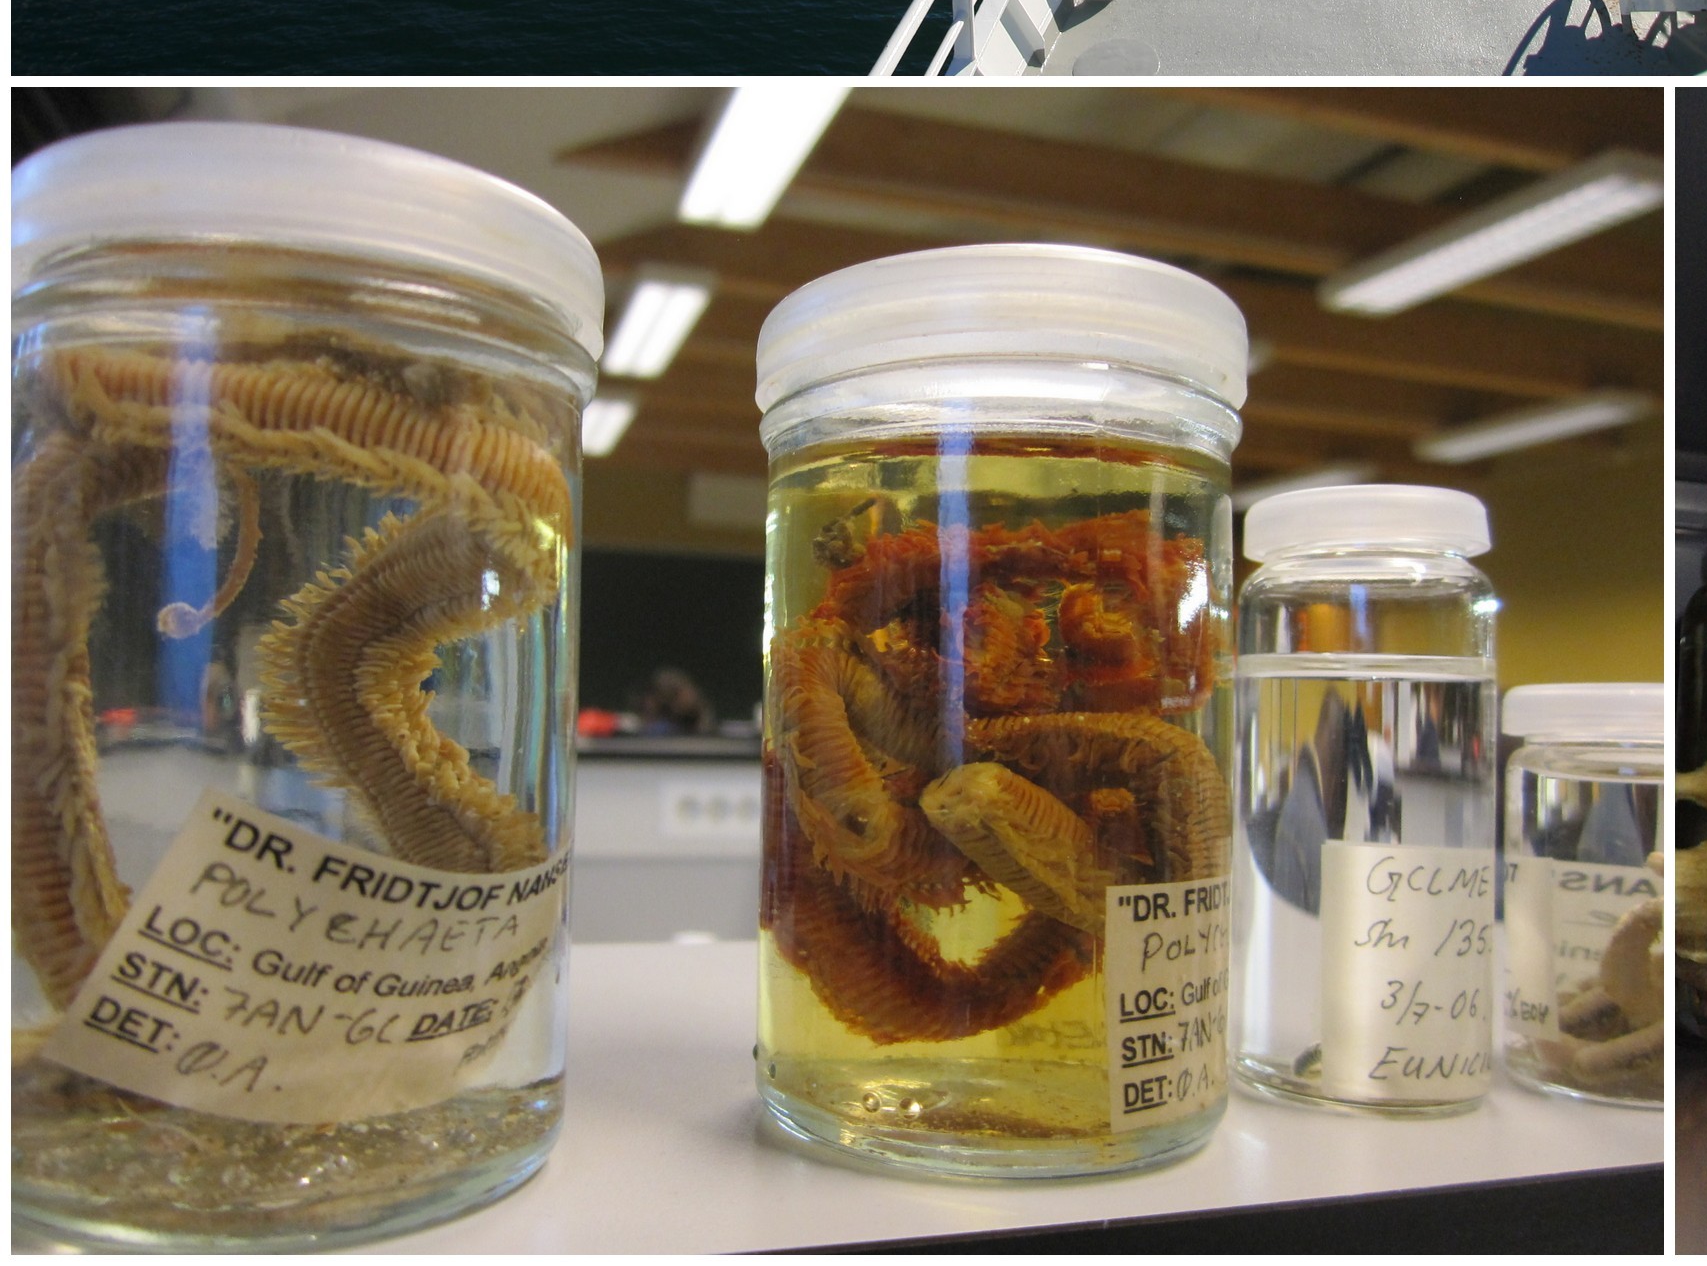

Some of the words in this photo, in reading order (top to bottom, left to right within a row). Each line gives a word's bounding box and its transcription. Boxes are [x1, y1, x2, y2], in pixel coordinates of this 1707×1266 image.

[212, 807, 296, 875] "DR.
[311, 855, 503, 913] FRIDTJOF
[1118, 892, 1177, 922] "DR.
[138, 904, 243, 972] LOC:
[252, 948, 334, 988] Gulf
[333, 961, 369, 995] of
[372, 970, 475, 999] Guinea,
[111, 950, 209, 1014] STN:
[1120, 986, 1176, 1023] LOC:
[1181, 976, 1212, 1007] Gulf
[83, 994, 182, 1054] DET:
[1122, 1032, 1175, 1068] STN:
[1123, 1074, 1173, 1114] DET:
